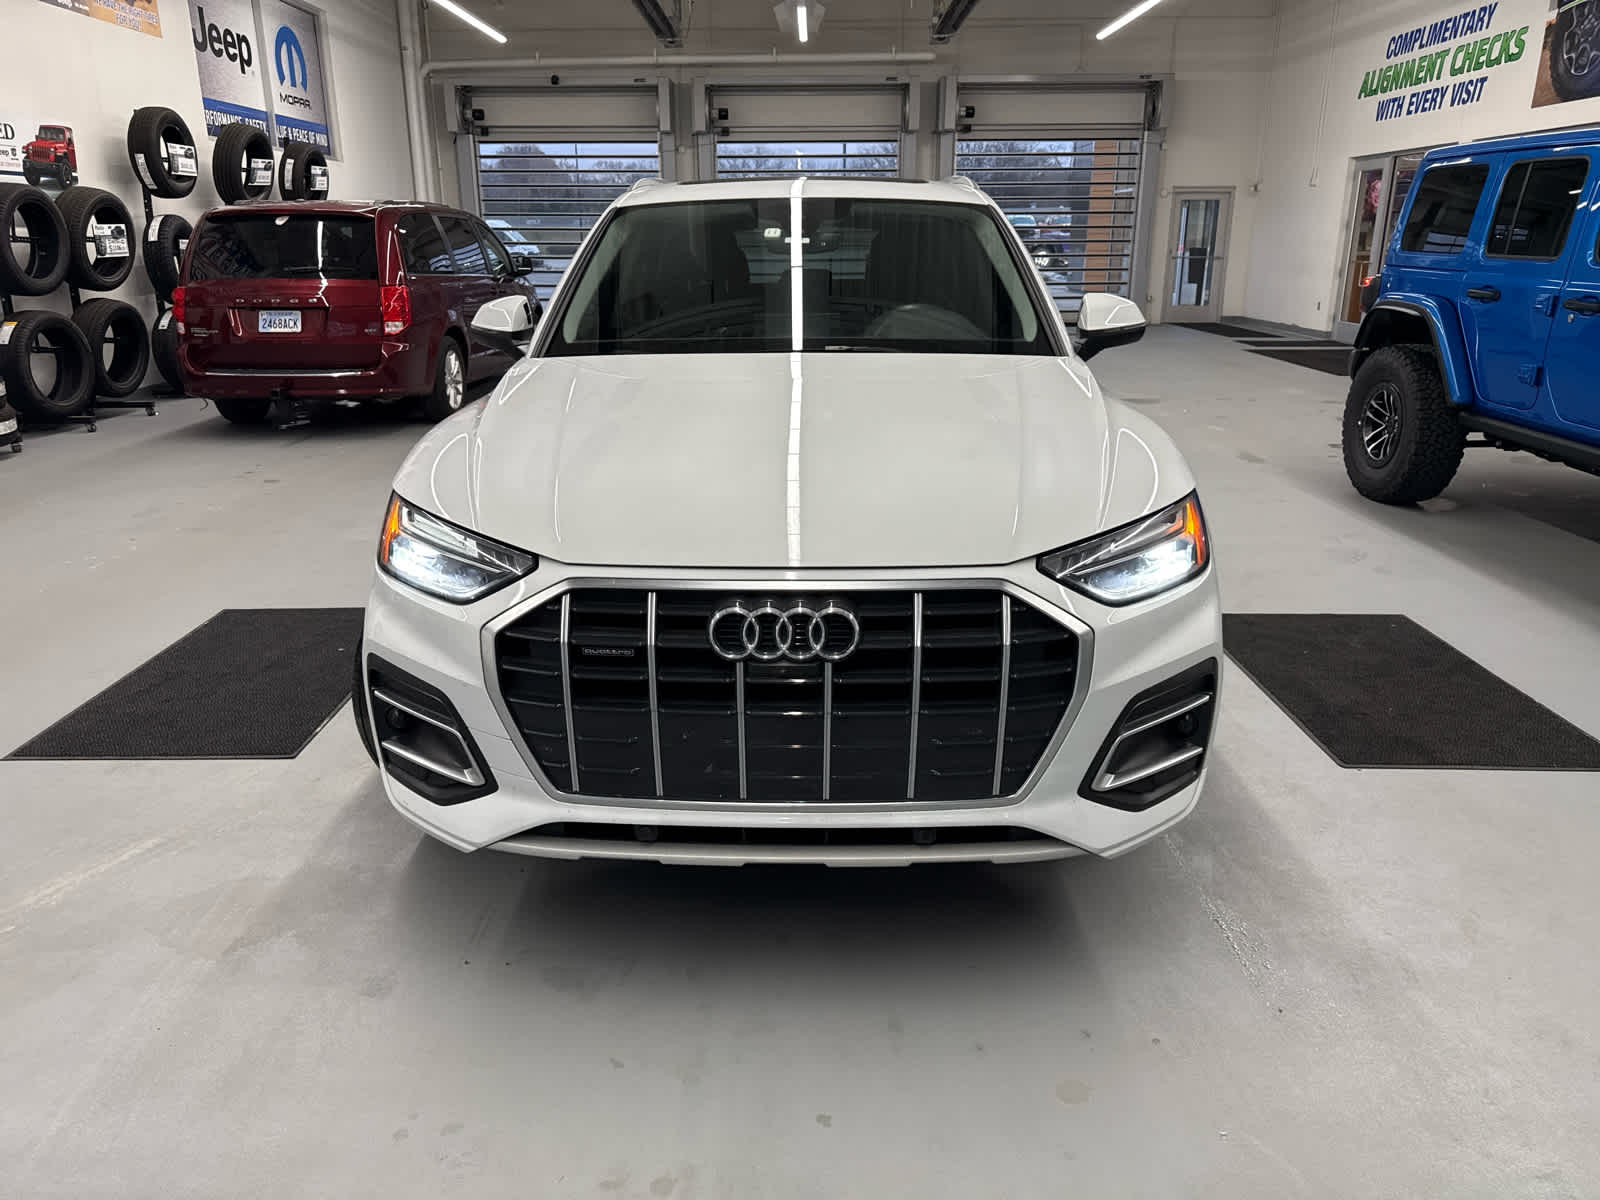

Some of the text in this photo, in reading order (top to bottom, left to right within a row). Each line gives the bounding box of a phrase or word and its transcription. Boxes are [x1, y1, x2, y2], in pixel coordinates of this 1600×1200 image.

[192, 7, 252, 75] Jeep
[1386, 2, 1498, 60] COMPLIMENTARY
[1358, 26, 1529, 99] ALIGNMENT CHECKS
[279, 91, 312, 110] MOPAR
[1375, 76, 1488, 122] WITH EVERY VISIT
[293, 128, 309, 143] PEACE
[309, 131, 315, 144] OF
[316, 132, 328, 147] MIND
